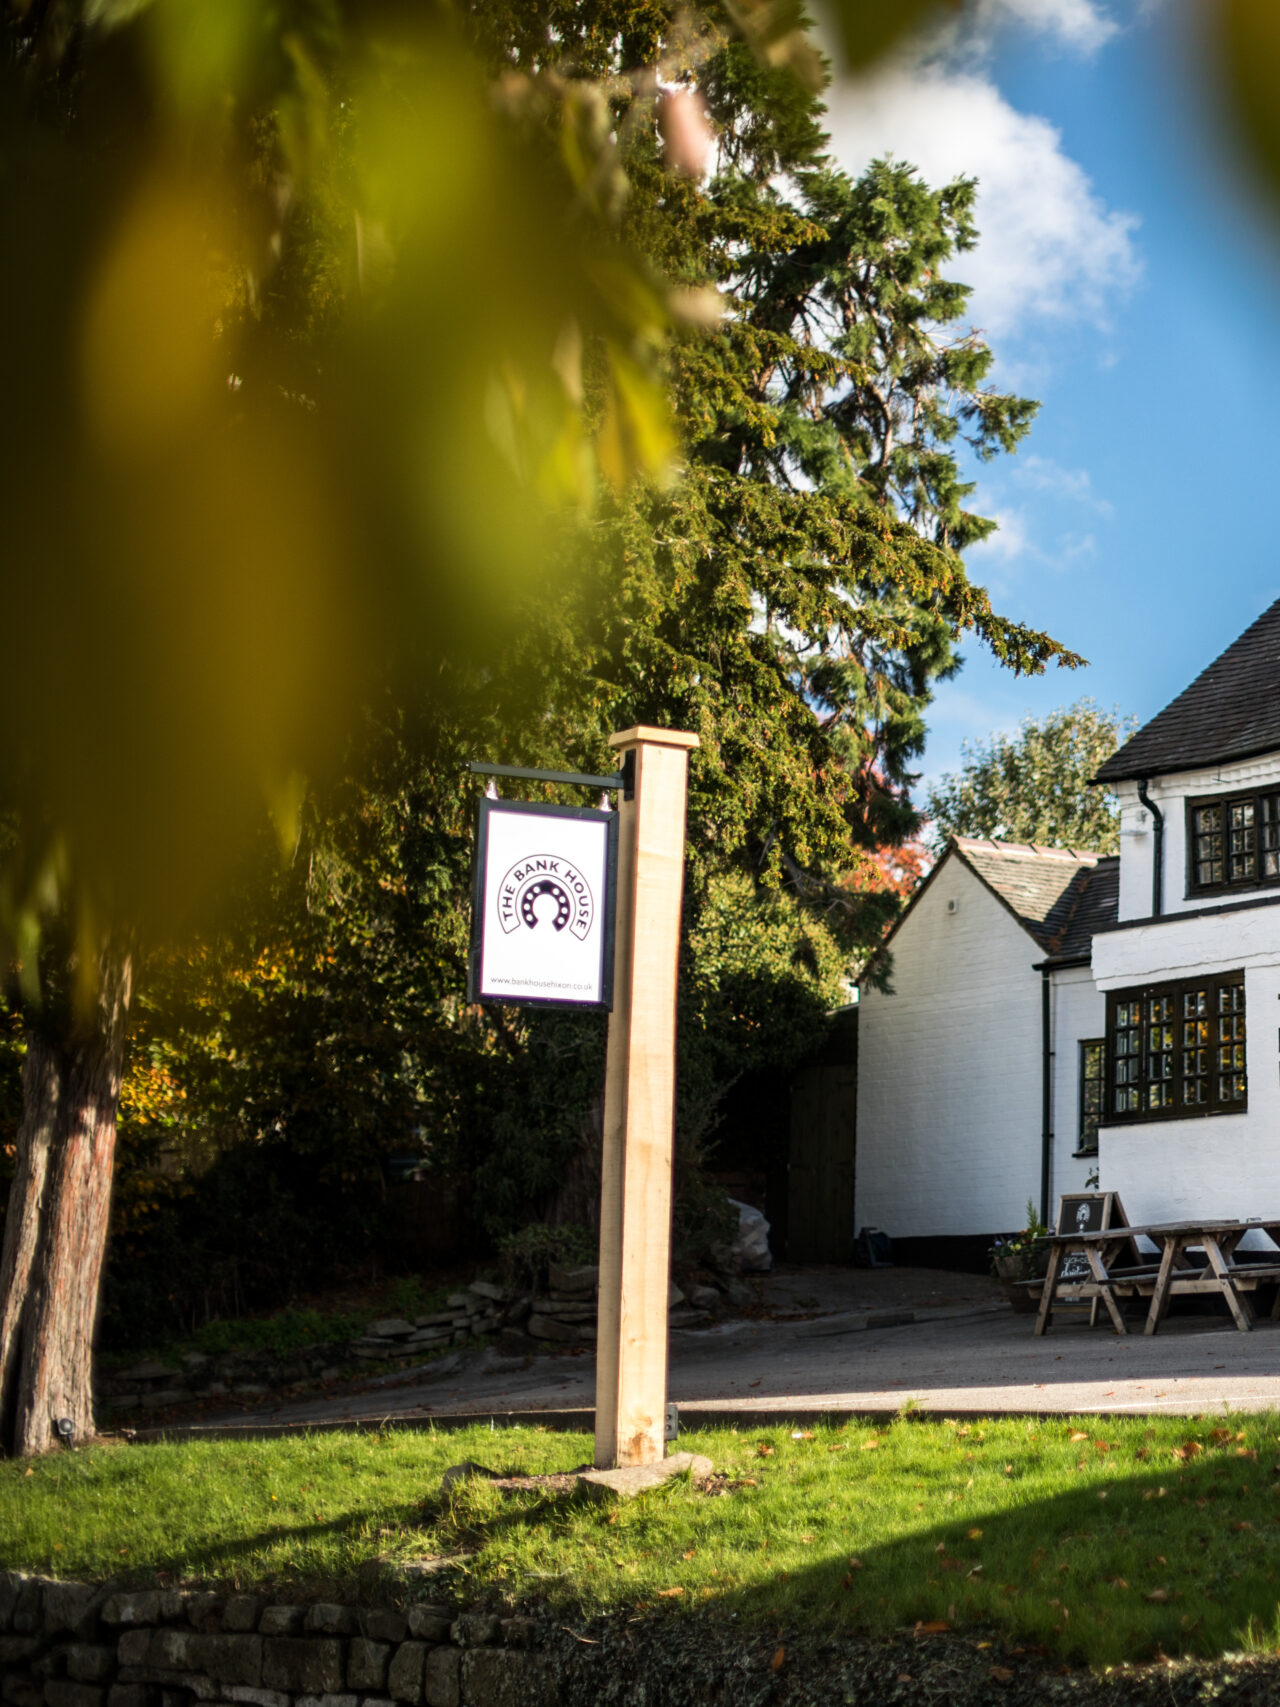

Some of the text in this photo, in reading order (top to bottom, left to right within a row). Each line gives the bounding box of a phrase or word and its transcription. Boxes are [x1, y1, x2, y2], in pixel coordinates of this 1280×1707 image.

[502, 860, 590, 930] THE BANK HOUSE
